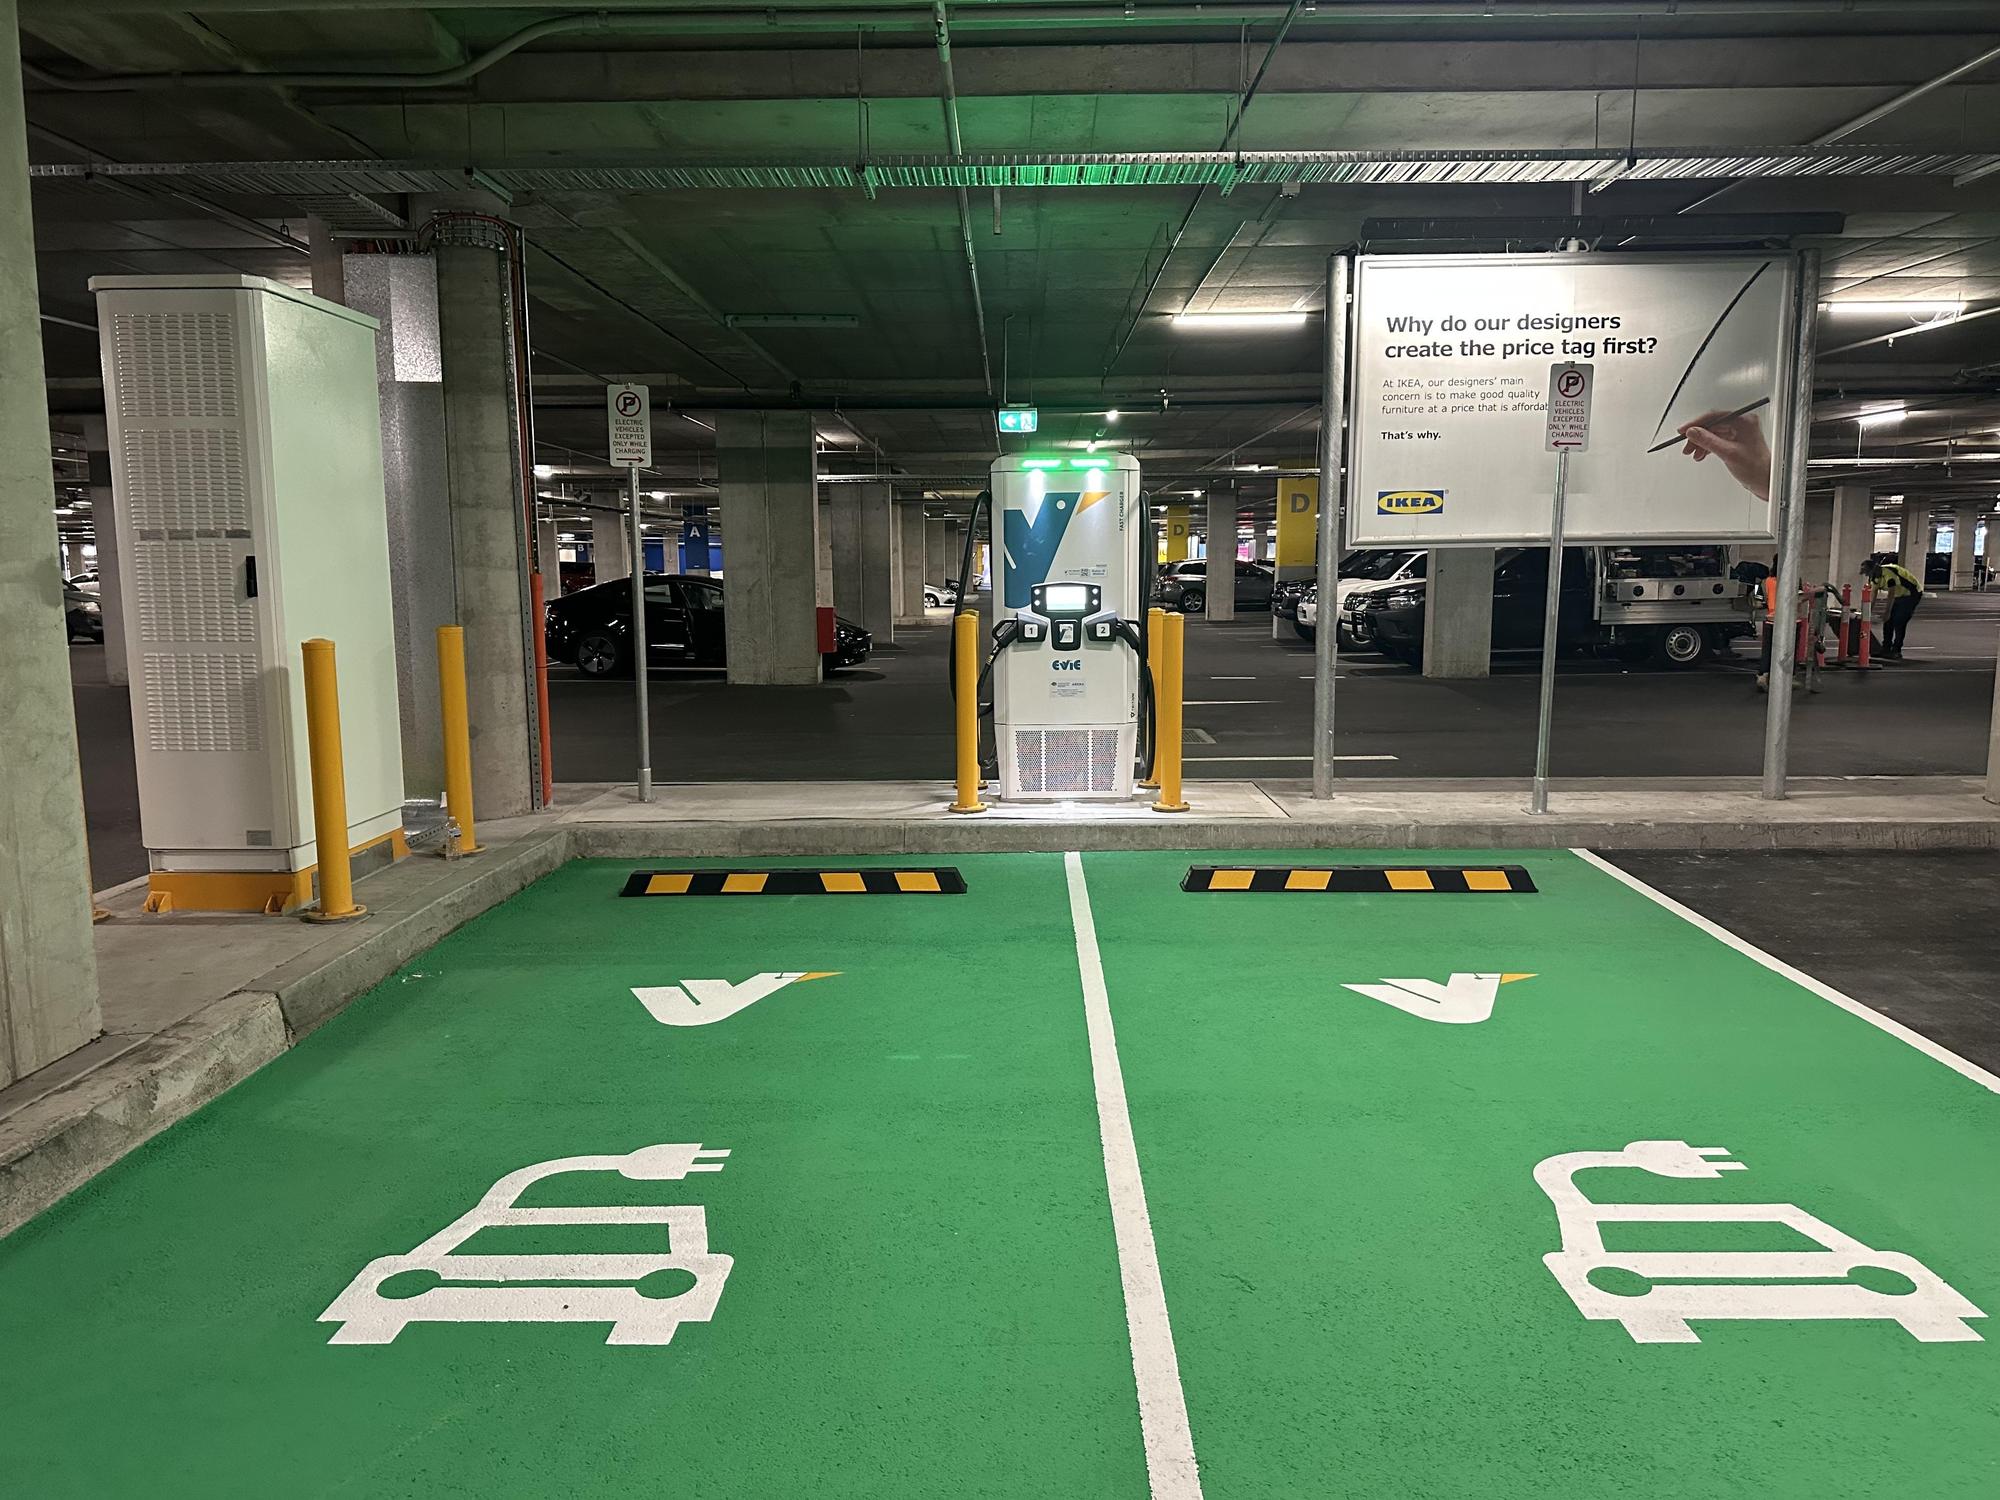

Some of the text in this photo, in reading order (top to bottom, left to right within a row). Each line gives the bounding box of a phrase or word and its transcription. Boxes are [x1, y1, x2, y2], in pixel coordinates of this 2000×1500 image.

[1386, 313, 1621, 336] Why do our designers
[1385, 337, 1658, 359] create the price tag first?
[1382, 379, 1393, 388] At
[1397, 379, 1424, 389] IKEA,
[1500, 378, 1524, 386] main
[1382, 389, 1540, 401] concern is to make good quality
[1381, 405, 1424, 415] furniture
[1427, 405, 1438, 413] at
[1451, 404, 1475, 414] price
[1478, 402, 1497, 412] that
[1500, 402, 1509, 411] is
[1417, 430, 1441, 440] why.
[1291, 493, 1311, 514] D
[1386, 497, 1437, 508] IKEA
[689, 526, 701, 538] A
[1174, 524, 1184, 536] D
[577, 544, 585, 552] B
[1028, 627, 1034, 635] 1
[1100, 626, 1107, 634] 2
